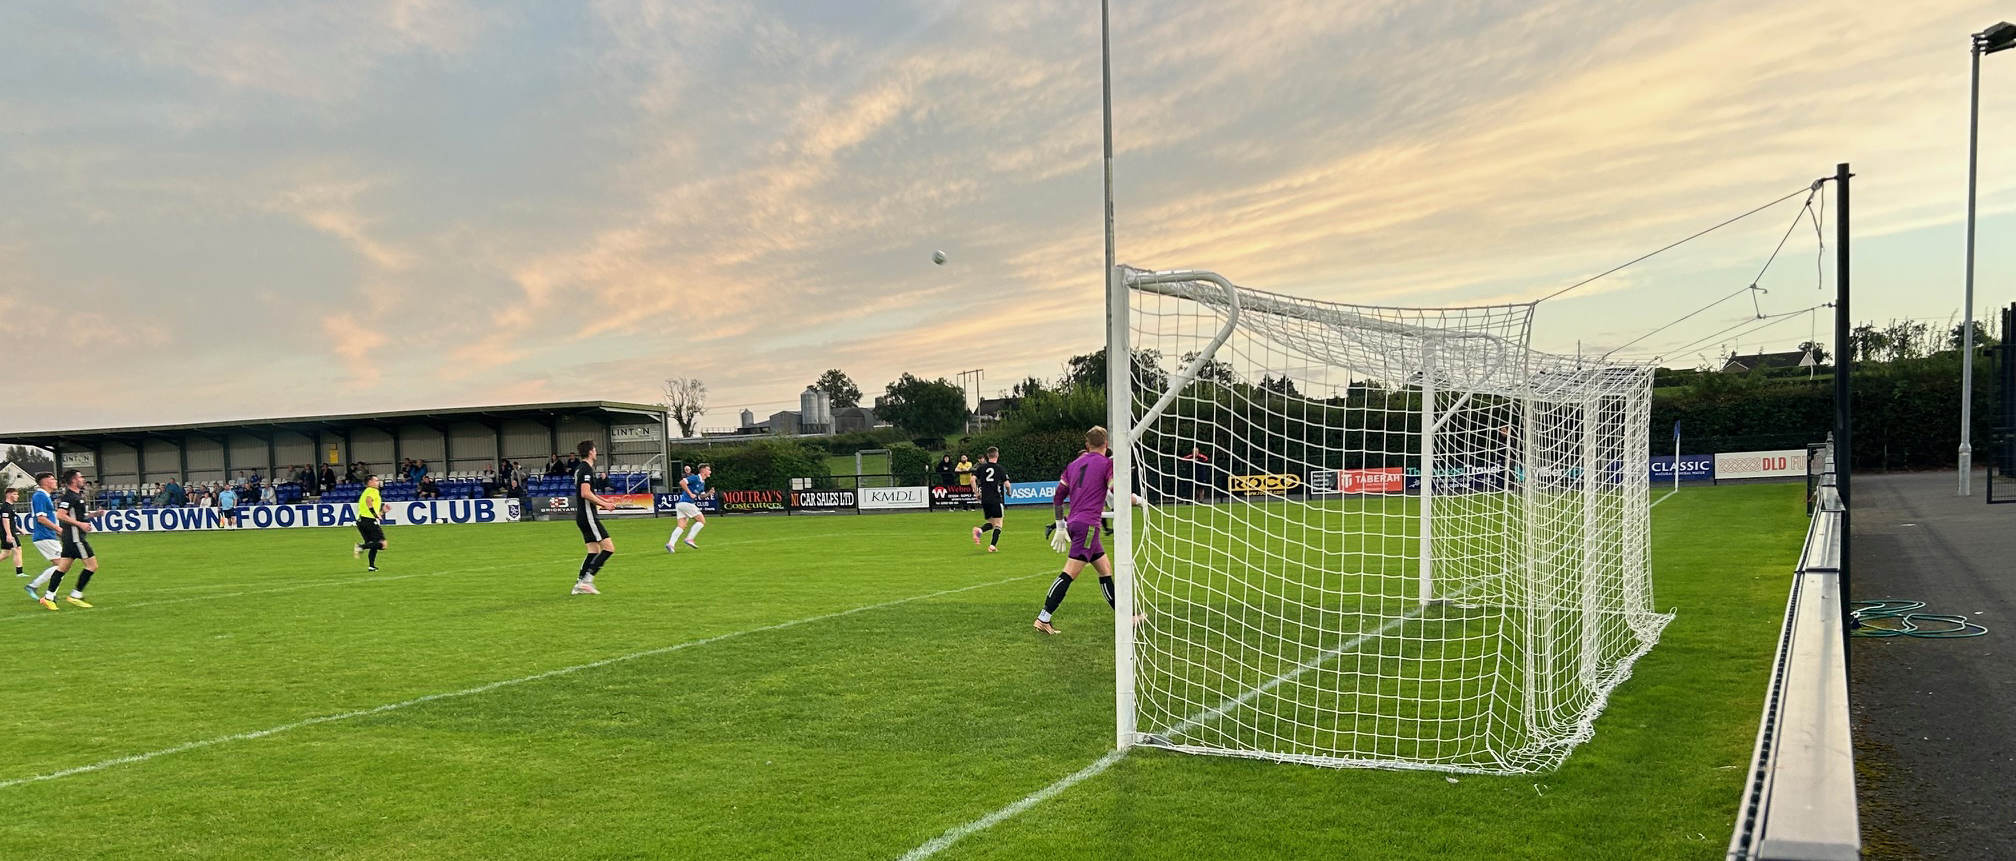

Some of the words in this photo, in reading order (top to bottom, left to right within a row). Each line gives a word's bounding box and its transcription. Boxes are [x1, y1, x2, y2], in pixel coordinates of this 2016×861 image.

[1651, 461, 1710, 472] CLASSIC
[1762, 457, 1786, 471] DLD
[985, 467, 995, 482] 2
[1078, 463, 1089, 488] 1
[1231, 475, 1298, 489] ROCO
[722, 490, 782, 503] MOUTRAY'S
[800, 492, 817, 507] CAR
[817, 492, 839, 506] SALES
[840, 491, 854, 506] LTD
[872, 490, 916, 502] KMDL
[1011, 487, 1038, 498] ASSA
[407, 500, 496, 525] CLUB
